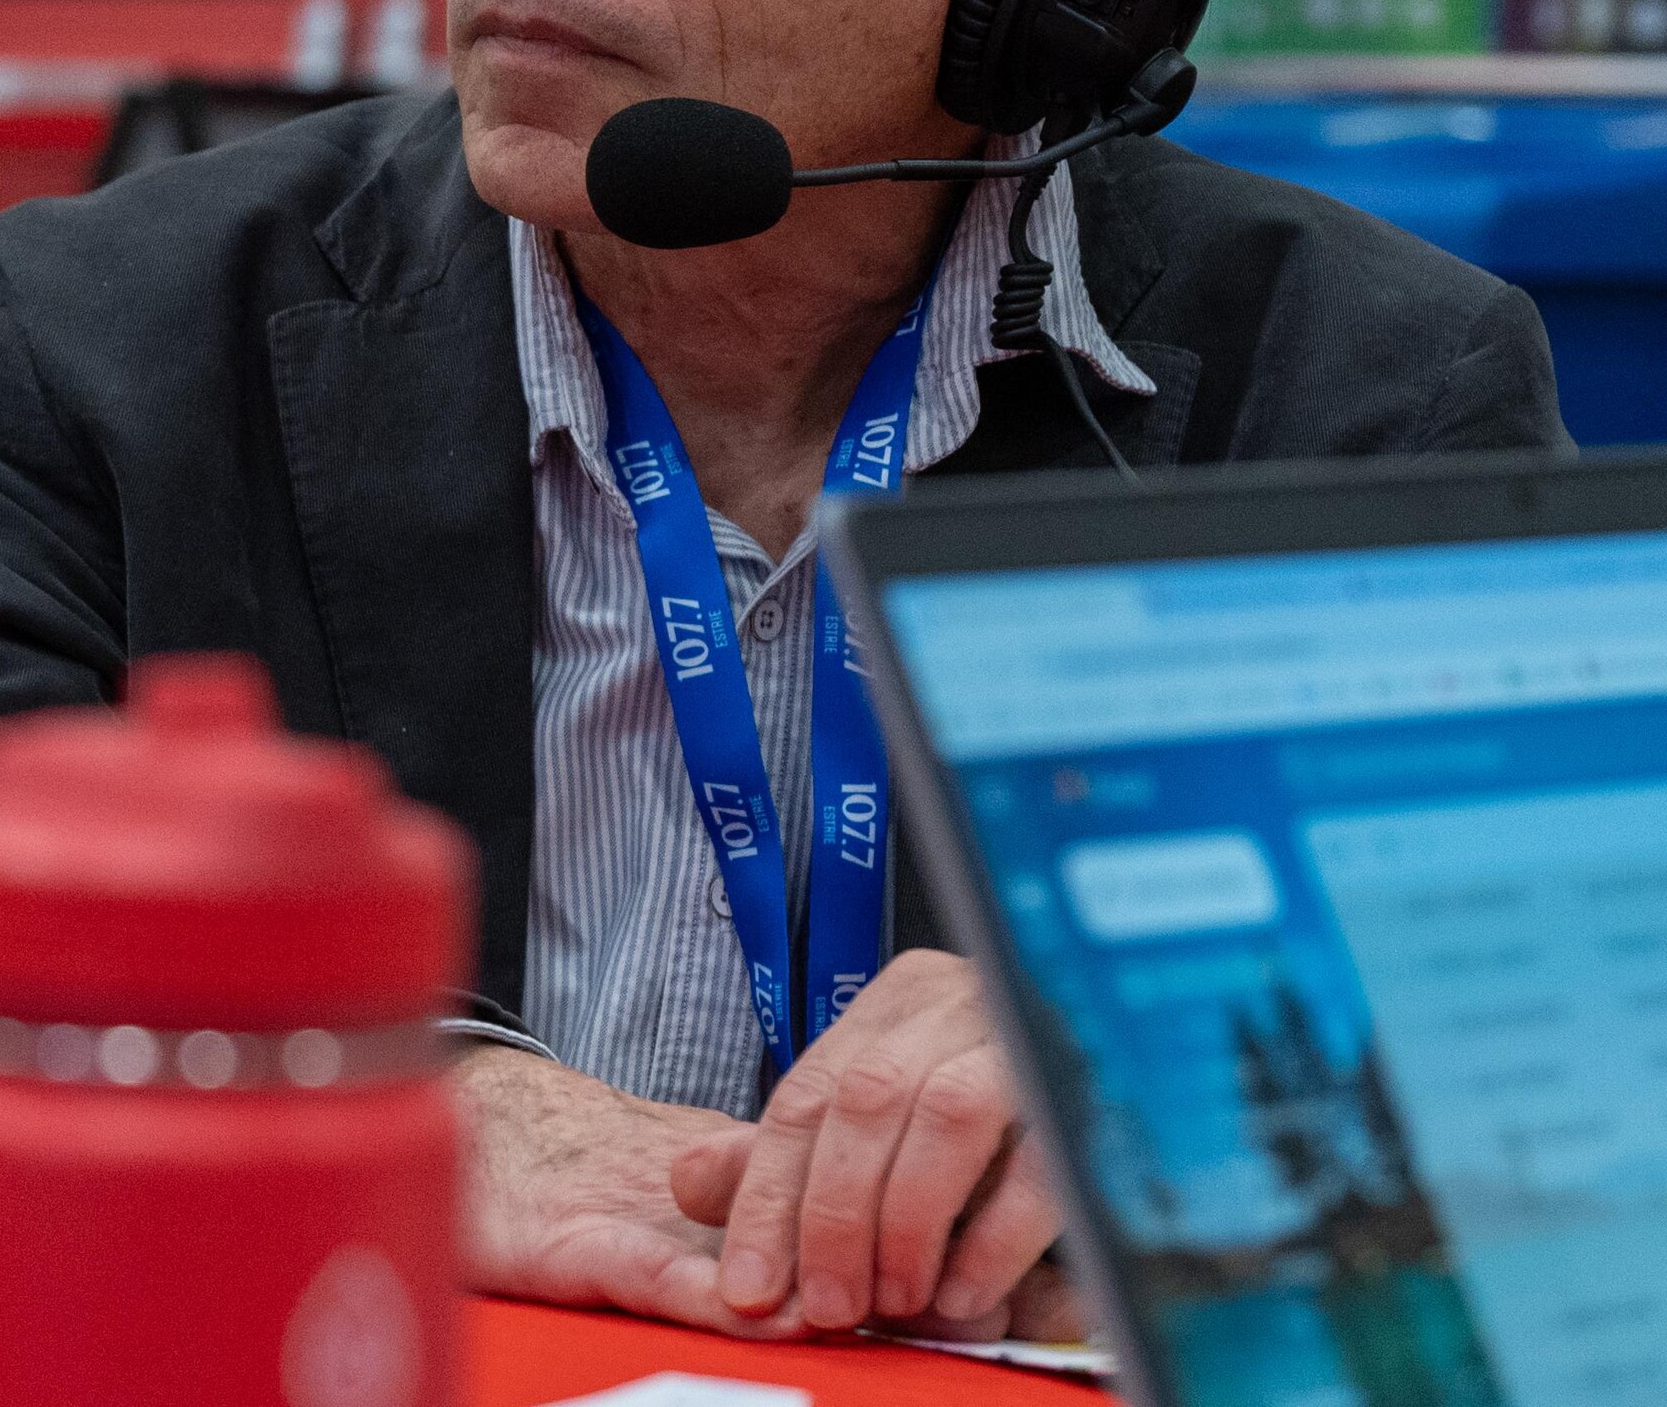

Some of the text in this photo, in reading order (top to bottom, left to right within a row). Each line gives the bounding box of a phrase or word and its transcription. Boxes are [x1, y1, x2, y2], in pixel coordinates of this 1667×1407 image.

[615, 440, 671, 505] 107.7
[836, 438, 854, 469] ESTRIE
[853, 413, 898, 489] 107.7
[662, 596, 713, 682] 107.7
[708, 610, 728, 649] ESTRIE
[824, 615, 839, 654] ESTRIE
[704, 781, 758, 861] 107.7
[748, 794, 770, 833] ESTRIE
[823, 806, 836, 845] ESTRIE
[841, 782, 877, 869] 107.7
[753, 961, 780, 1045] 107.7
